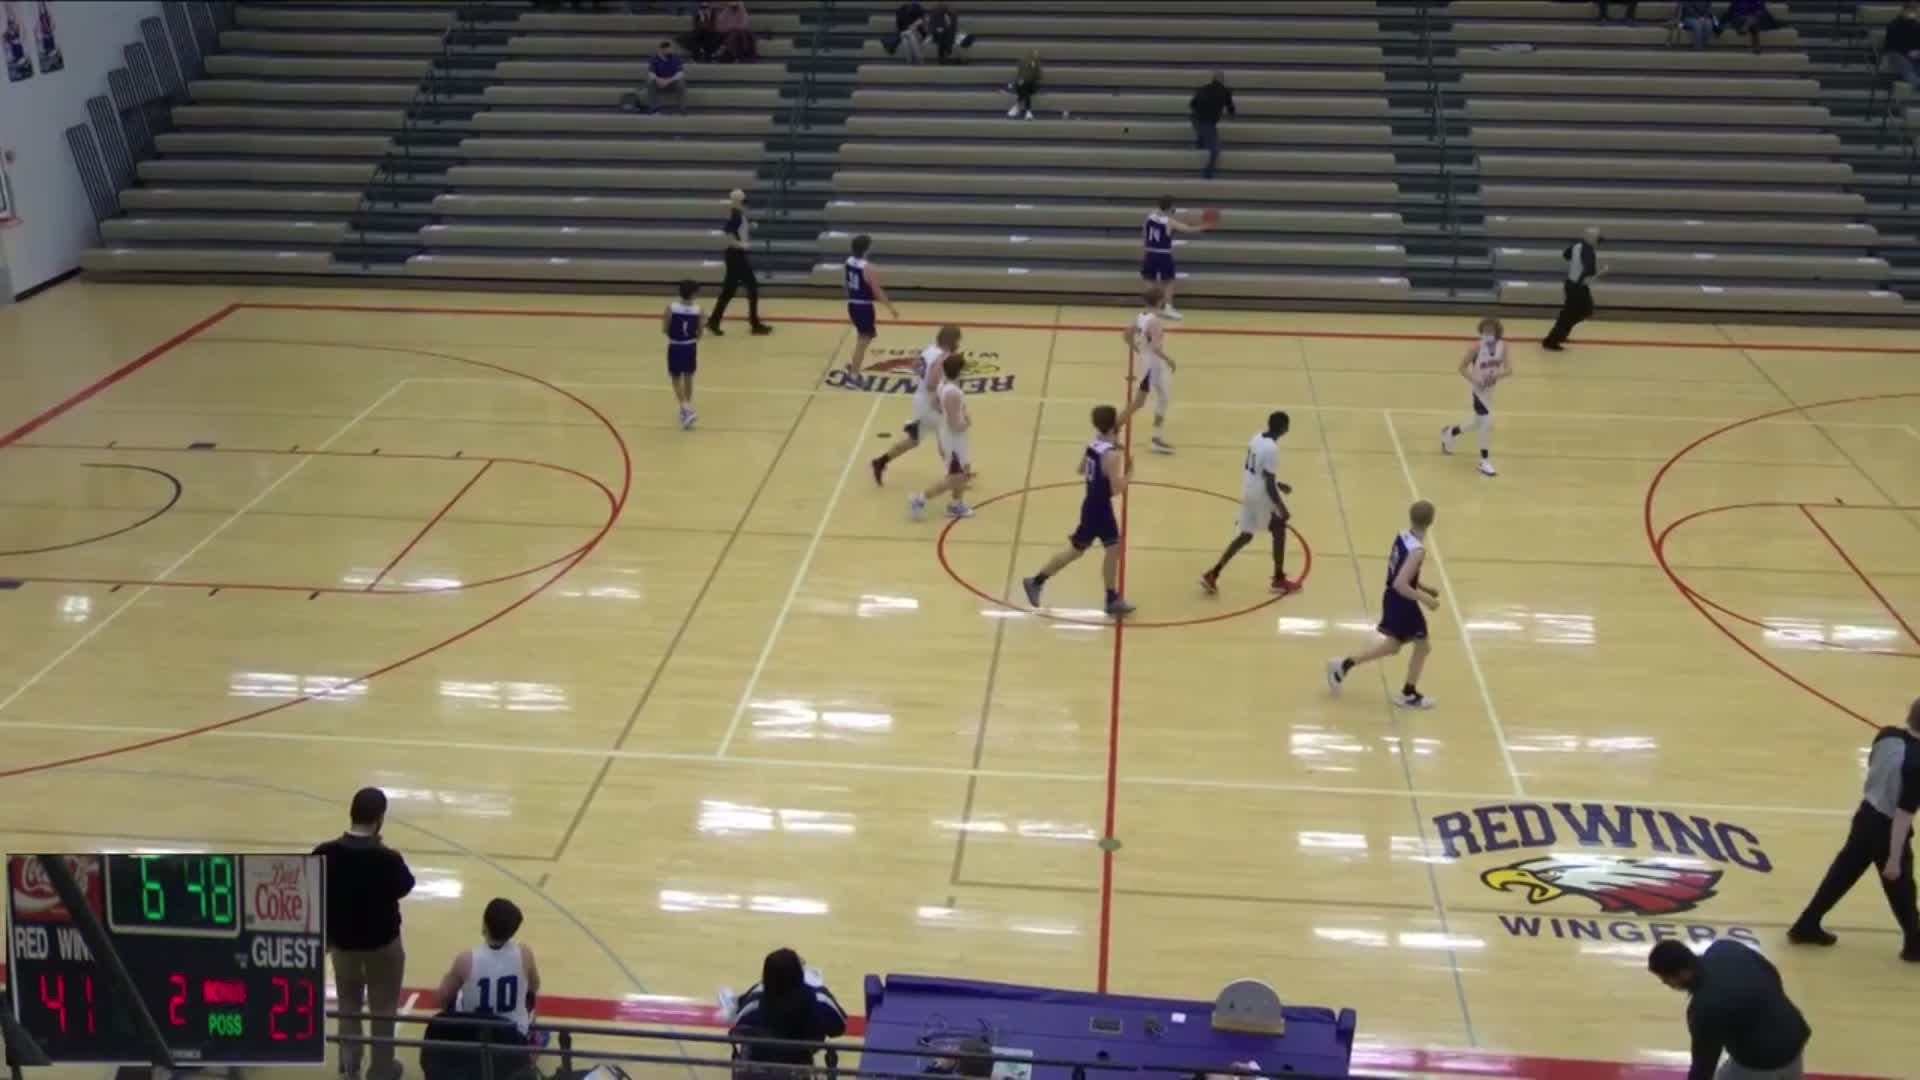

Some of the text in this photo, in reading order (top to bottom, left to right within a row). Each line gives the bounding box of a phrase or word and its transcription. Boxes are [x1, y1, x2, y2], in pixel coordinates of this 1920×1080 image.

[141, 855, 164, 920] 6
[185, 855, 233, 923] 48
[255, 882, 304, 920] Coke
[16, 927, 95, 961] RED WIN
[251, 936, 321, 968] GUEST
[40, 975, 95, 1033] 41
[168, 975, 188, 1025] 2
[269, 977, 315, 1040] 23
[475, 975, 518, 1017] 10
[208, 1013, 243, 1037] POSS
